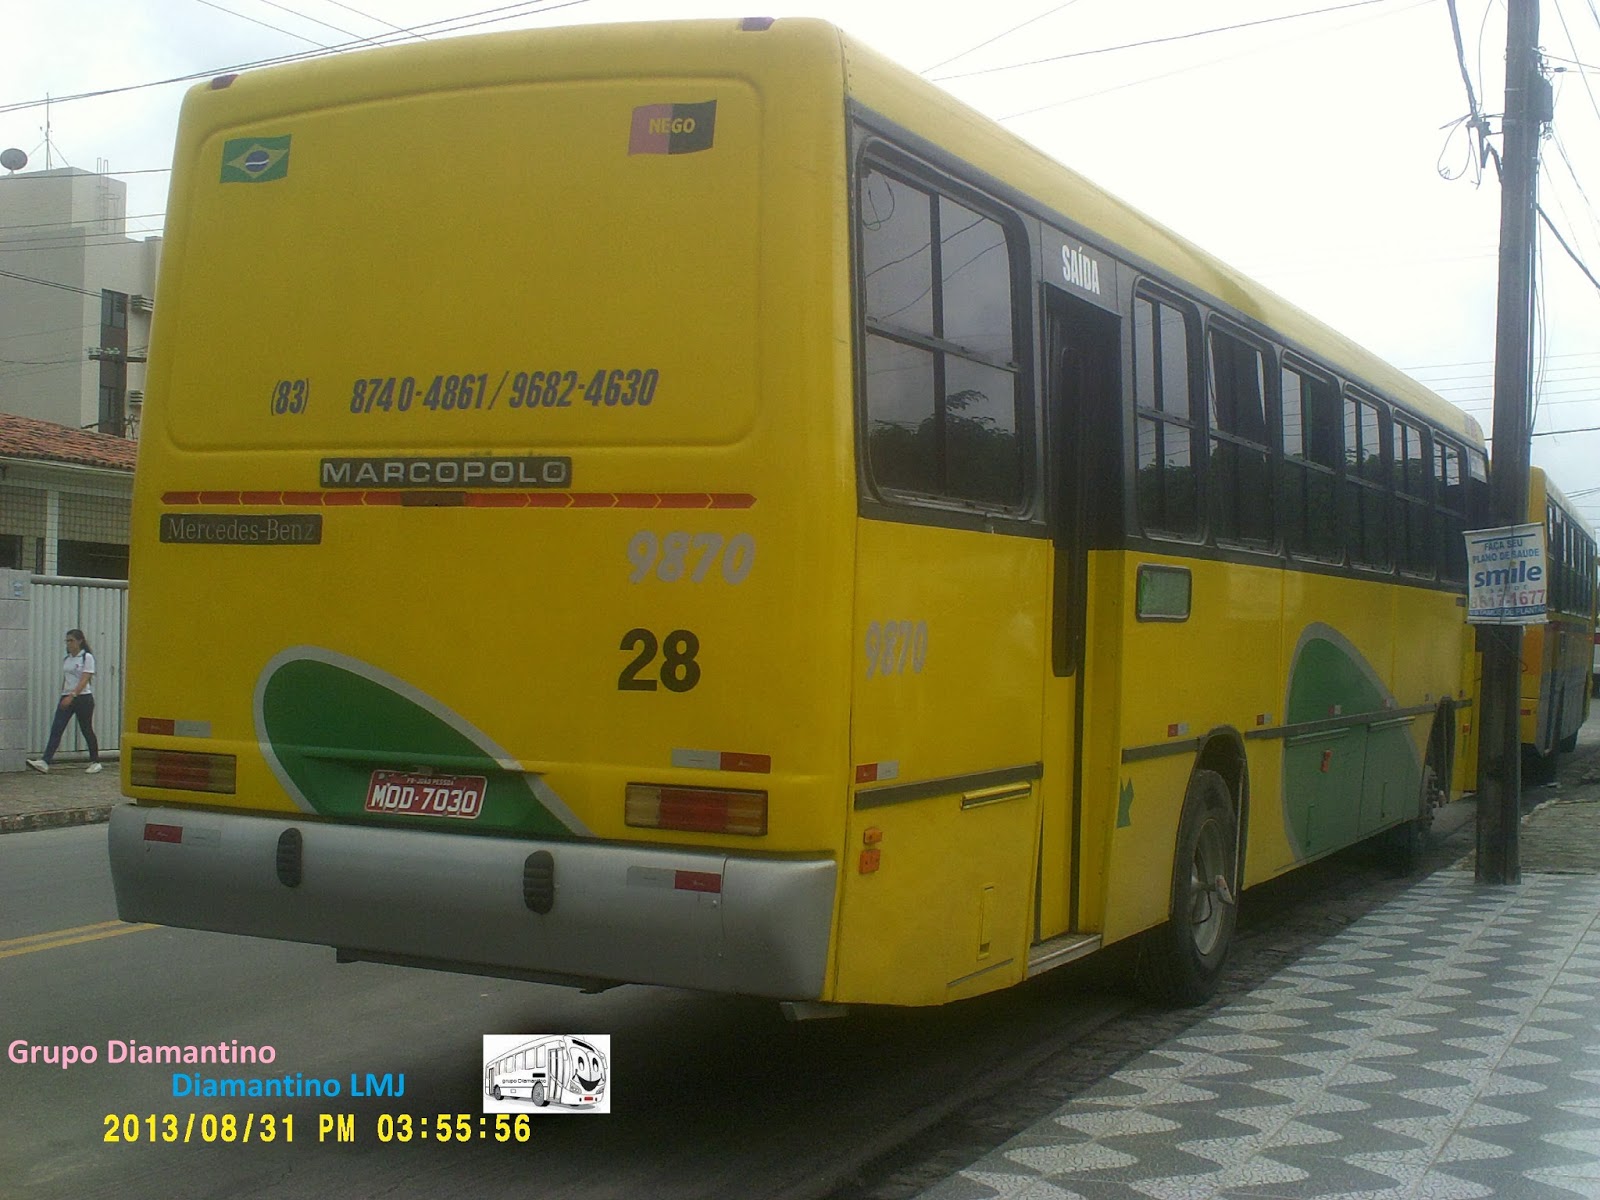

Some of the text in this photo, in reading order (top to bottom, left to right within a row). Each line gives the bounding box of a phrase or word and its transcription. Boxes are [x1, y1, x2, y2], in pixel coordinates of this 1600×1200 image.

[649, 117, 696, 134] NEGO
[1062, 244, 1100, 295] SAÍDA
[270, 378, 309, 416] (83)
[350, 373, 488, 413] 8740-4861
[509, 368, 659, 408] 9682-4630
[322, 460, 568, 484] MARCOPOLO
[167, 517, 315, 542] Mercedes-Benz
[1507, 539, 1523, 548] SEU
[626, 530, 756, 585] 9870
[1474, 561, 1542, 588] smile
[618, 628, 701, 692] 28
[865, 620, 929, 680] 9870
